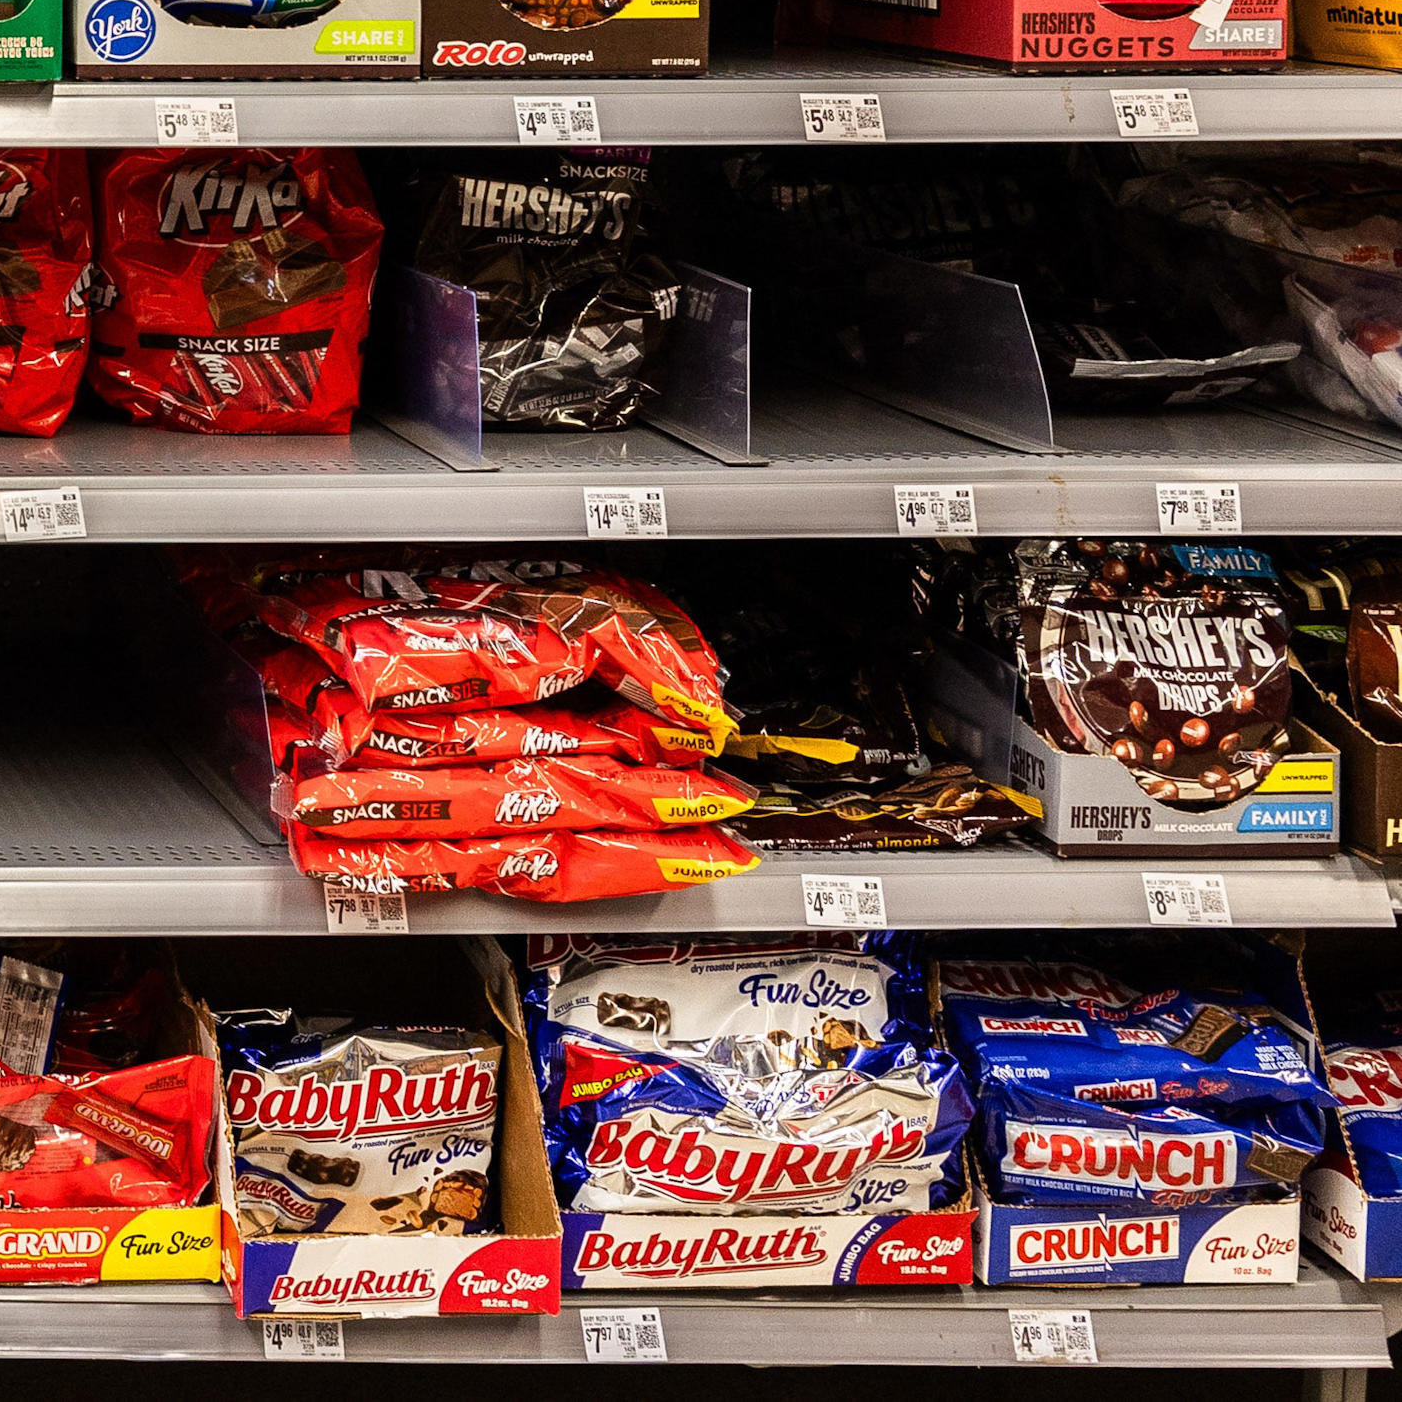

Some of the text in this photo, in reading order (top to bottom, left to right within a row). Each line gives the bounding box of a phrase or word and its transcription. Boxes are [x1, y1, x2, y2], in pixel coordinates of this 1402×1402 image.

[89, 7, 149, 45] York
[1204, 27, 1264, 44] SHARE
[435, 41, 594, 66] Rolo unwrapped
[1021, 37, 1175, 59] NUGGETS
[462, 180, 632, 240] HERSHEY'S
[497, 233, 578, 247] milk chocolate
[1087, 611, 1276, 668] HERSHEY'S
[1158, 682, 1221, 712] DROPS
[333, 803, 442, 823] SNACK SIZE
[669, 805, 718, 818] JUMBO
[1070, 807, 1151, 830] HERSHEY'S
[1155, 822, 1233, 833] MILK CHOCOLATE
[876, 836, 939, 849] almonds
[571, 1066, 643, 1098] JUMBO BAG
[1014, 1129, 1228, 1184] CRUNCH
[121, 1232, 213, 1259] Fun Size
[877, 1236, 963, 1265] Fun Size
[1015, 1222, 1172, 1264] CRUNCH
[514, 1300, 528, 1310] Bag
